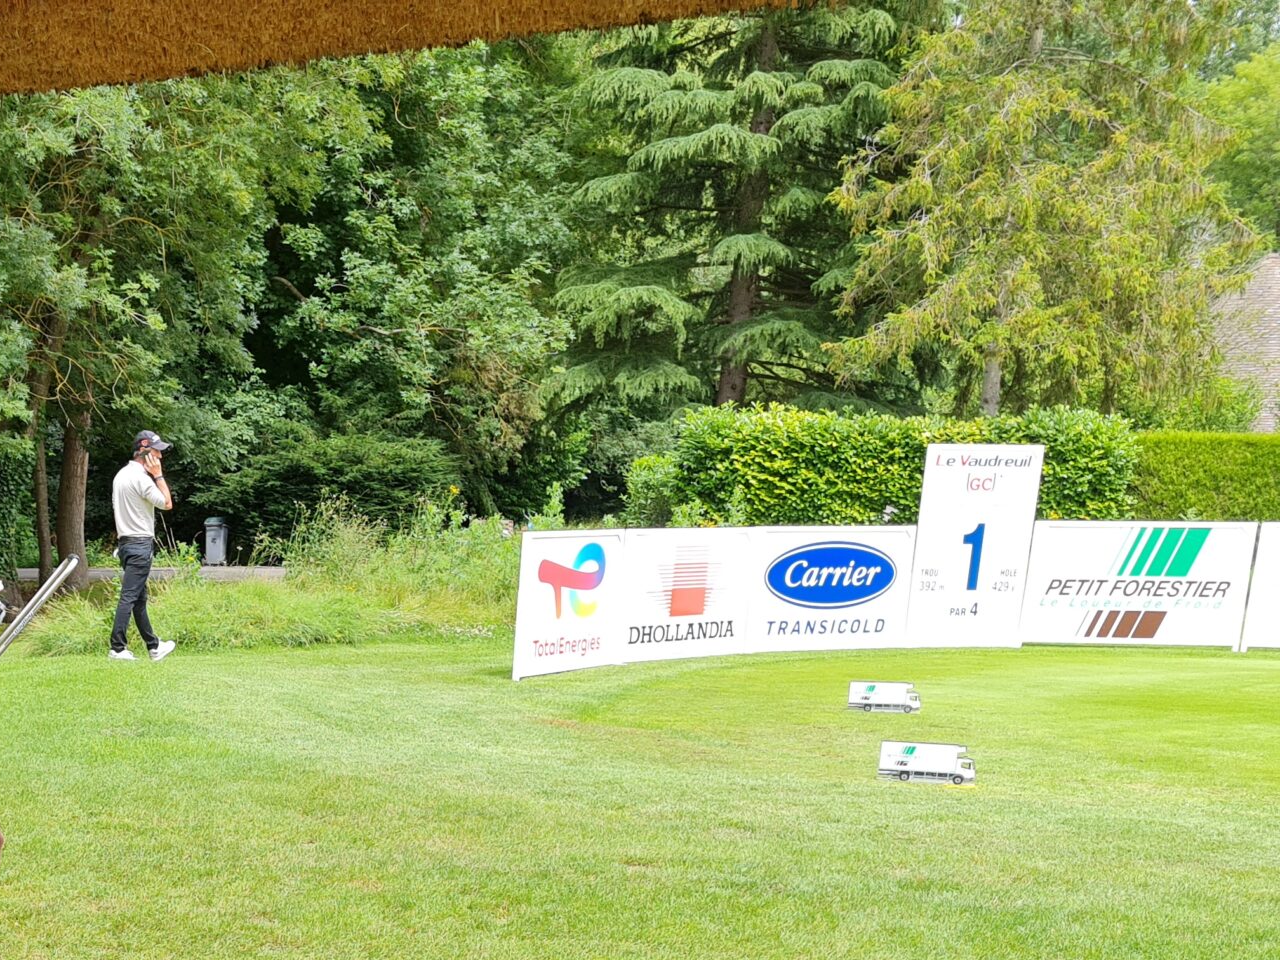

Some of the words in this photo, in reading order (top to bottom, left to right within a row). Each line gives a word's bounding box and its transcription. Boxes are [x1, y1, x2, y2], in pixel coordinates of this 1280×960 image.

[936, 454, 956, 467] Le
[960, 454, 1033, 468] Vaudreuil
[963, 523, 986, 591] 1
[784, 559, 882, 588] Carrier
[920, 568, 939, 577] TROU
[1000, 568, 1018, 577] HOLE
[919, 580, 937, 592] 392
[1045, 579, 1109, 597] PETIT
[1109, 579, 1232, 598] FORESTIER
[949, 607, 967, 617] PAR
[969, 602, 979, 617] 4
[627, 619, 735, 645] DHOLLANDIA
[766, 618, 886, 636] TRANSICOLD
[532, 636, 601, 658] TotalEnergies
